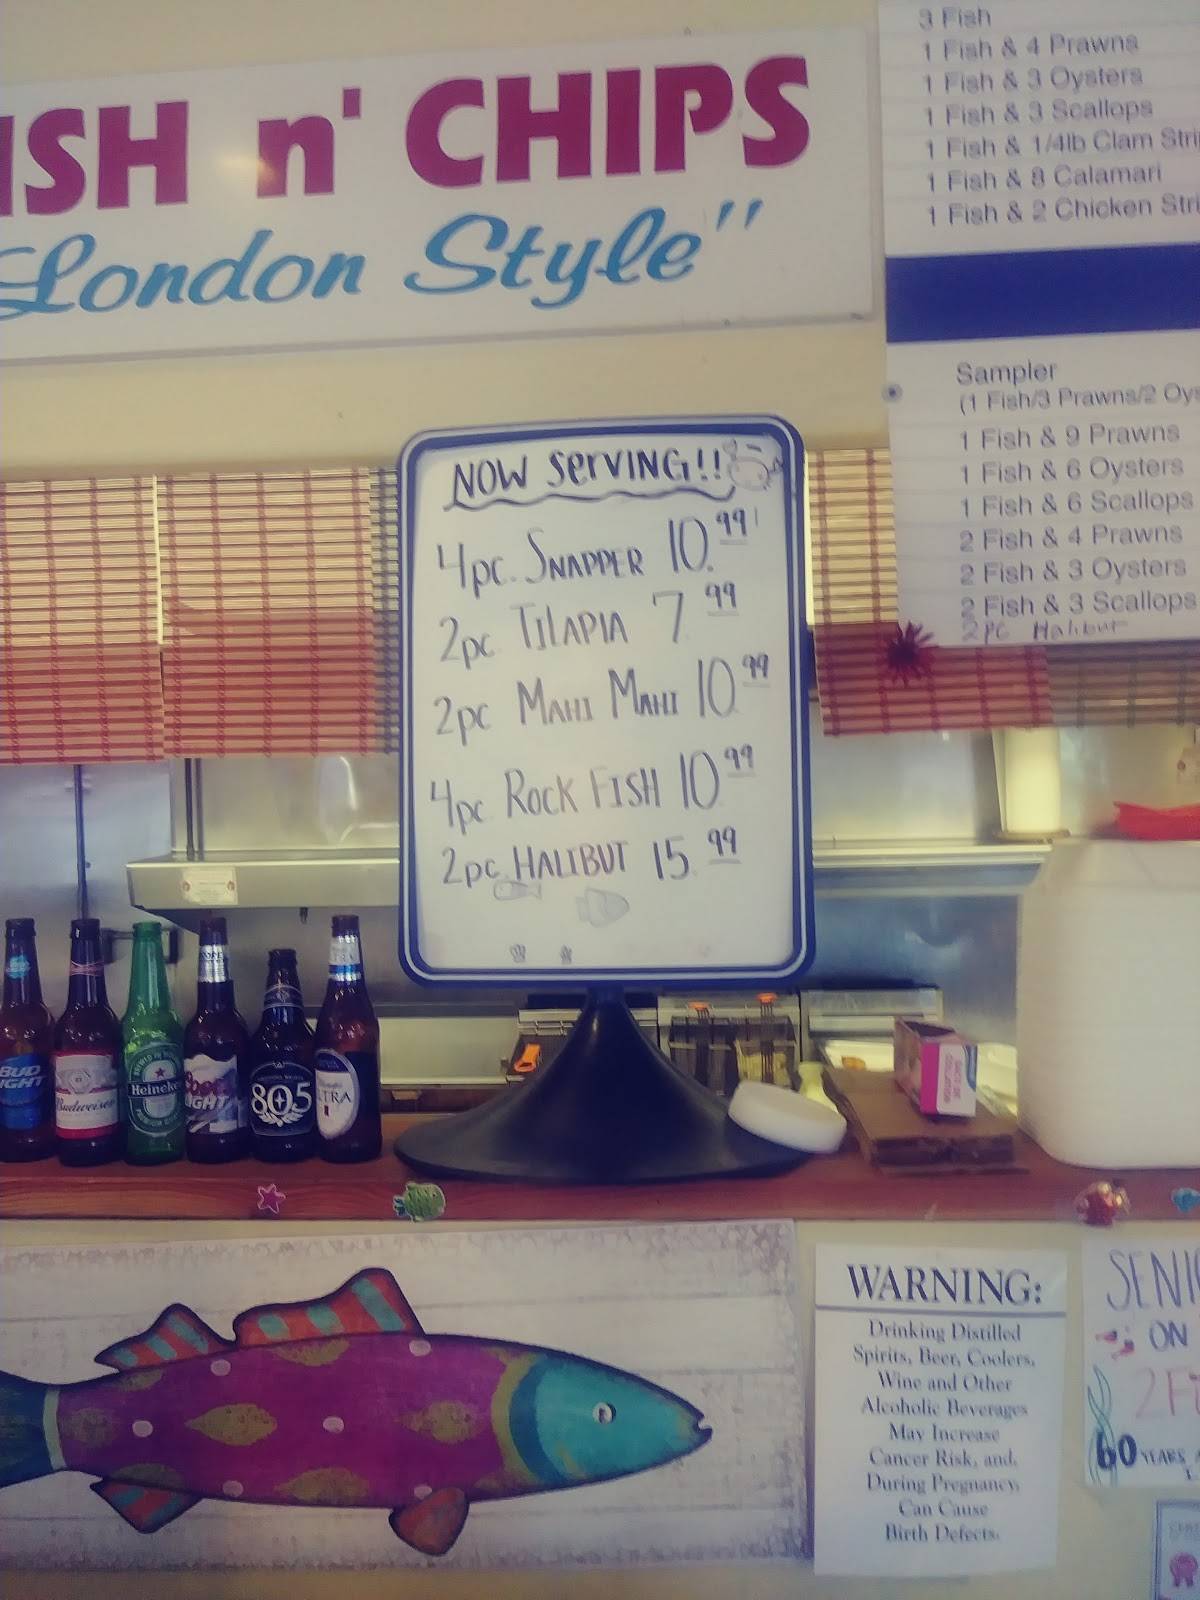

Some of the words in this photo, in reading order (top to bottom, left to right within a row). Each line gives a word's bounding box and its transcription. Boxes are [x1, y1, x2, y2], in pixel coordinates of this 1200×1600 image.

[919, 8, 933, 31] 3
[942, 5, 992, 29] Fish
[924, 40, 932, 62] 1
[943, 38, 993, 62] Fish
[1001, 37, 1017, 59] &
[1026, 36, 1040, 56] 4
[1050, 32, 1140, 56] Prawns
[924, 72, 932, 94] 1
[944, 70, 994, 94] Fish
[1002, 69, 1019, 92] &
[1027, 67, 1042, 90] 3
[1050, 65, 1144, 94] Oysters
[405, 54, 810, 188] CHIPS
[926, 105, 933, 126] 1
[945, 103, 995, 127] Fish
[1003, 102, 1020, 124] &
[1029, 101, 1043, 124] 3
[1051, 98, 1154, 123] Scallops
[926, 138, 934, 160] 1
[947, 136, 996, 160] Fish
[1005, 135, 1021, 157] &
[1093, 128, 1153, 153] Clam
[1160, 126, 1200, 150] Stri
[927, 171, 935, 192] 1
[947, 169, 998, 192] Fish
[1006, 168, 1022, 190] &
[1031, 166, 1045, 189] 8
[1054, 160, 1163, 188] Calamari
[928, 205, 936, 227] 1
[949, 202, 999, 226] Fish
[1007, 200, 1023, 223] &
[1032, 199, 1047, 223] 2
[1055, 196, 1153, 222] Chicken
[0, 229, 366, 321] London
[956, 358, 1058, 389] Sampler
[961, 430, 969, 450] 1
[981, 427, 1031, 451] Fish
[1040, 425, 1057, 448] &
[1065, 425, 1080, 448] 9
[1089, 422, 1181, 446] Prawns
[453, 454, 527, 499] NOW
[961, 464, 969, 484] 1
[981, 461, 1032, 484] Fish
[1041, 460, 1058, 482] &
[1066, 458, 1081, 481] 6
[1089, 456, 1185, 485] Oysters
[961, 498, 969, 517] 1
[982, 495, 1033, 517] Fish
[1041, 493, 1058, 516] &
[1067, 491, 1082, 514] 6
[1091, 488, 1194, 516] Scallops
[959, 530, 975, 553] 2
[983, 527, 1033, 550] Fish
[1042, 526, 1058, 548] &
[1067, 525, 1081, 546] 4
[1092, 522, 1184, 546] Prawns
[960, 563, 975, 587] 2
[984, 560, 1034, 584] Fish
[1042, 559, 1059, 581] &
[1068, 558, 1083, 580] 3
[1092, 555, 1187, 584] Oysters
[961, 596, 976, 619] 2
[984, 594, 1034, 617] Fish
[1043, 593, 1060, 616] &
[1069, 592, 1084, 615] 3
[1093, 589, 1198, 616] Scallops
[513, 840, 629, 881] HALIBUT
[251, 1082, 313, 1115] 805
[846, 1263, 1042, 1306] WARNING:
[868, 1319, 945, 1344] Drinking
[951, 1322, 1022, 1343] Distilled
[1149, 1319, 1188, 1351] ON
[878, 1370, 922, 1391] Wine
[928, 1373, 957, 1391] and
[963, 1374, 1013, 1393] Other
[861, 1395, 941, 1417] Alcoholic
[947, 1398, 1028, 1420] Beverages
[889, 1422, 925, 1444] May
[932, 1423, 1000, 1442] Increase
[869, 1448, 929, 1467] Cancer
[866, 1472, 927, 1495] During
[899, 1499, 933, 1518] Can
[938, 1500, 989, 1519] Cause
[885, 1524, 929, 1543] Birth
